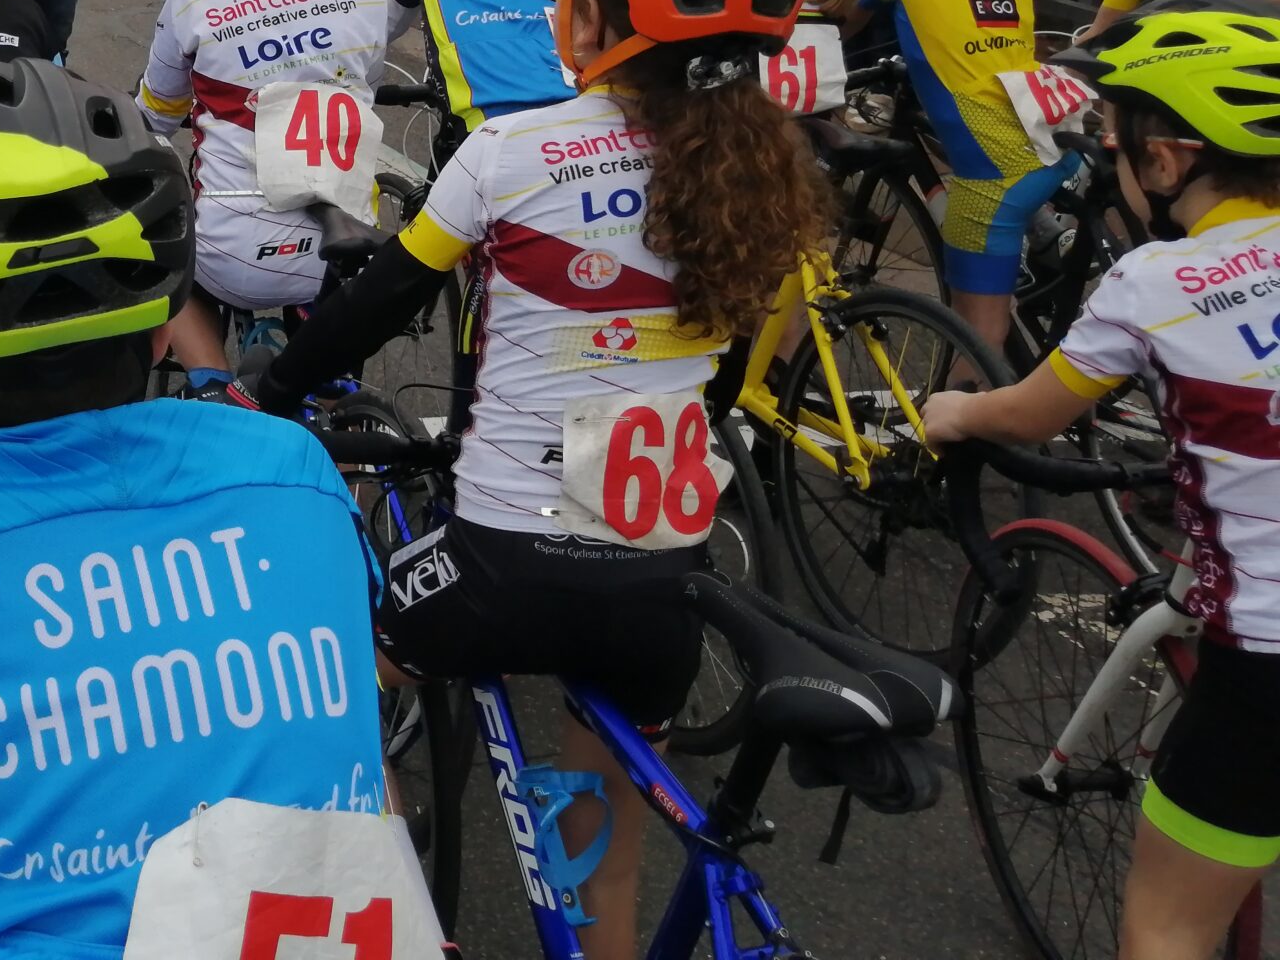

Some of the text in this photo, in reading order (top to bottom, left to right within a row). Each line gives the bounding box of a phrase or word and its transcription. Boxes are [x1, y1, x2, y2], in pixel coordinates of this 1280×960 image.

[212, 23, 244, 43] Ville
[247, 9, 308, 32] créative
[1123, 46, 1233, 72] ROCKRIDER
[247, 73, 258, 82] LE
[767, 45, 817, 113] 61
[284, 89, 362, 172] 40
[549, 157, 654, 185] Ville créat
[1192, 289, 1247, 317] Ville
[602, 402, 719, 541] 68
[534, 541, 564, 556] Espoir
[567, 547, 602, 560] Cycliste
[653, 787, 676, 815] ECSEL
